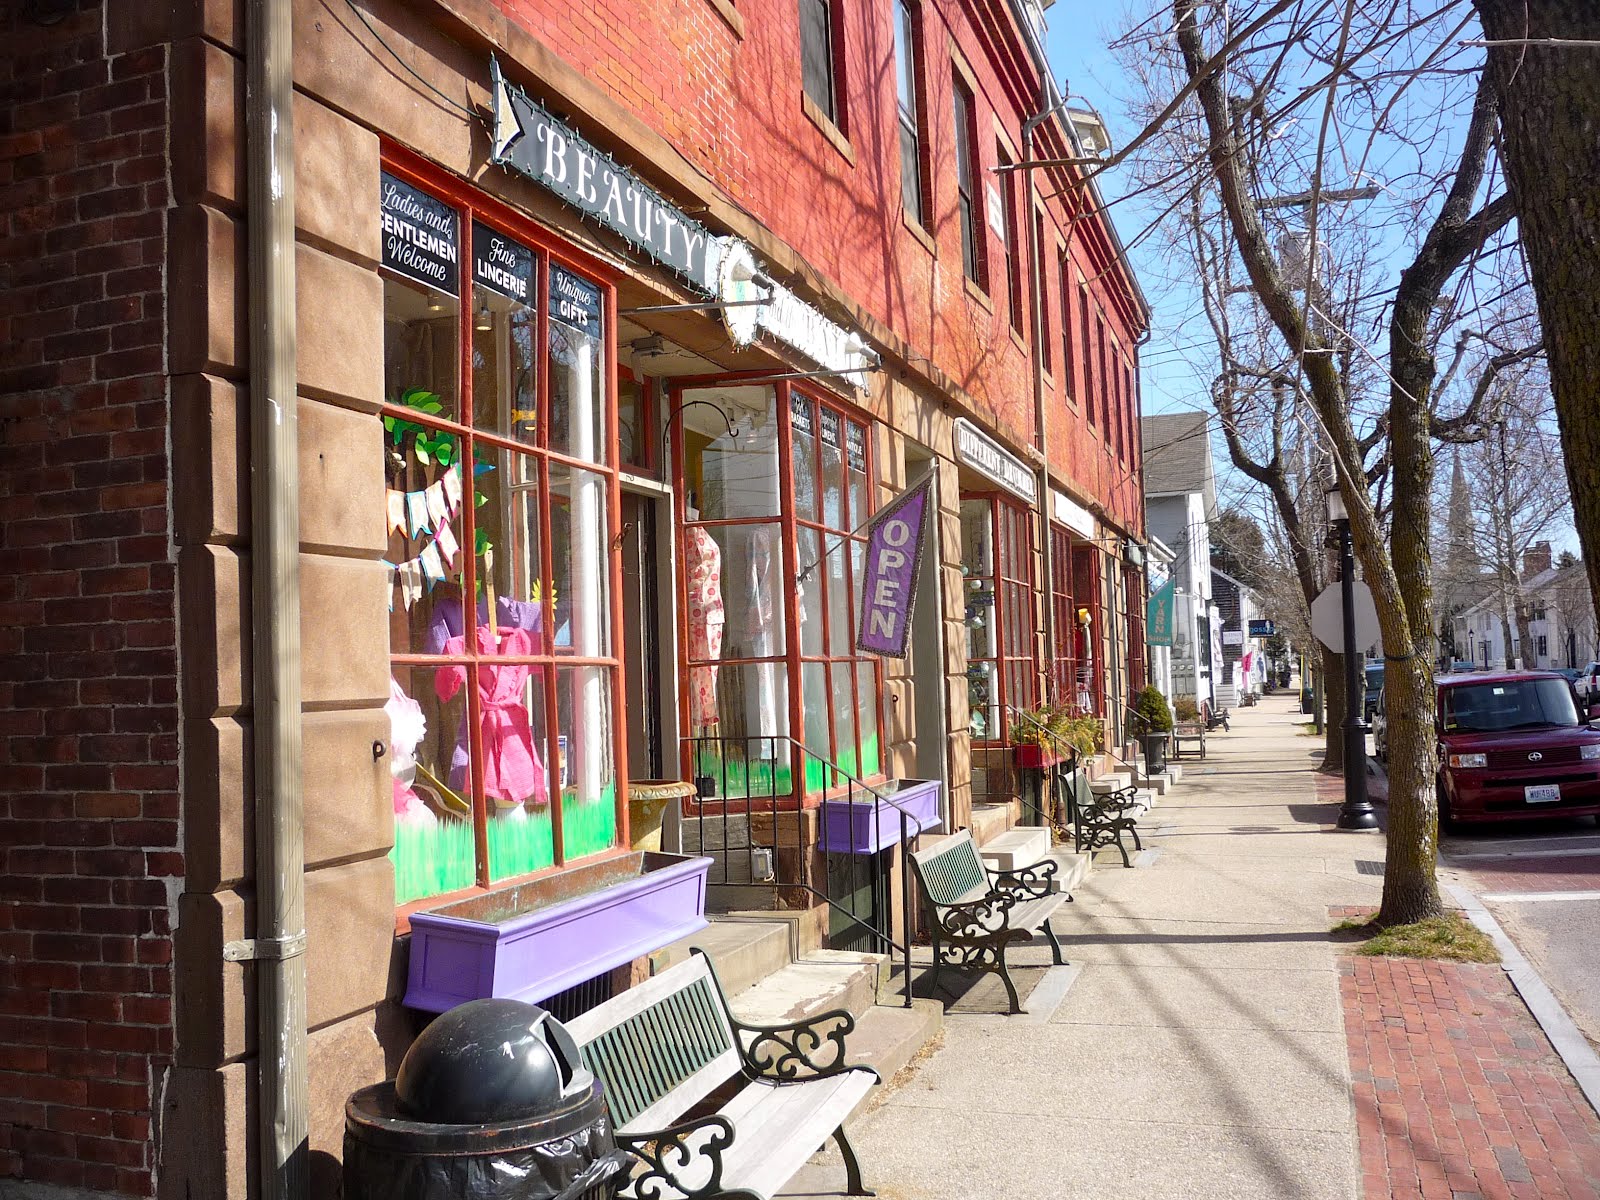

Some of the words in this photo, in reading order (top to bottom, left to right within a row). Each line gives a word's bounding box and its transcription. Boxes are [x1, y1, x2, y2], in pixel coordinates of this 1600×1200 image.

[381, 183, 424, 221] Ladies
[425, 211, 453, 240] and
[537, 122, 703, 271] BEAUTY
[388, 236, 446, 281] Welcome
[488, 237, 516, 268] Fine
[557, 272, 591, 305] Unique
[560, 300, 588, 326] GIFTS
[869, 519, 910, 638] OPEN
